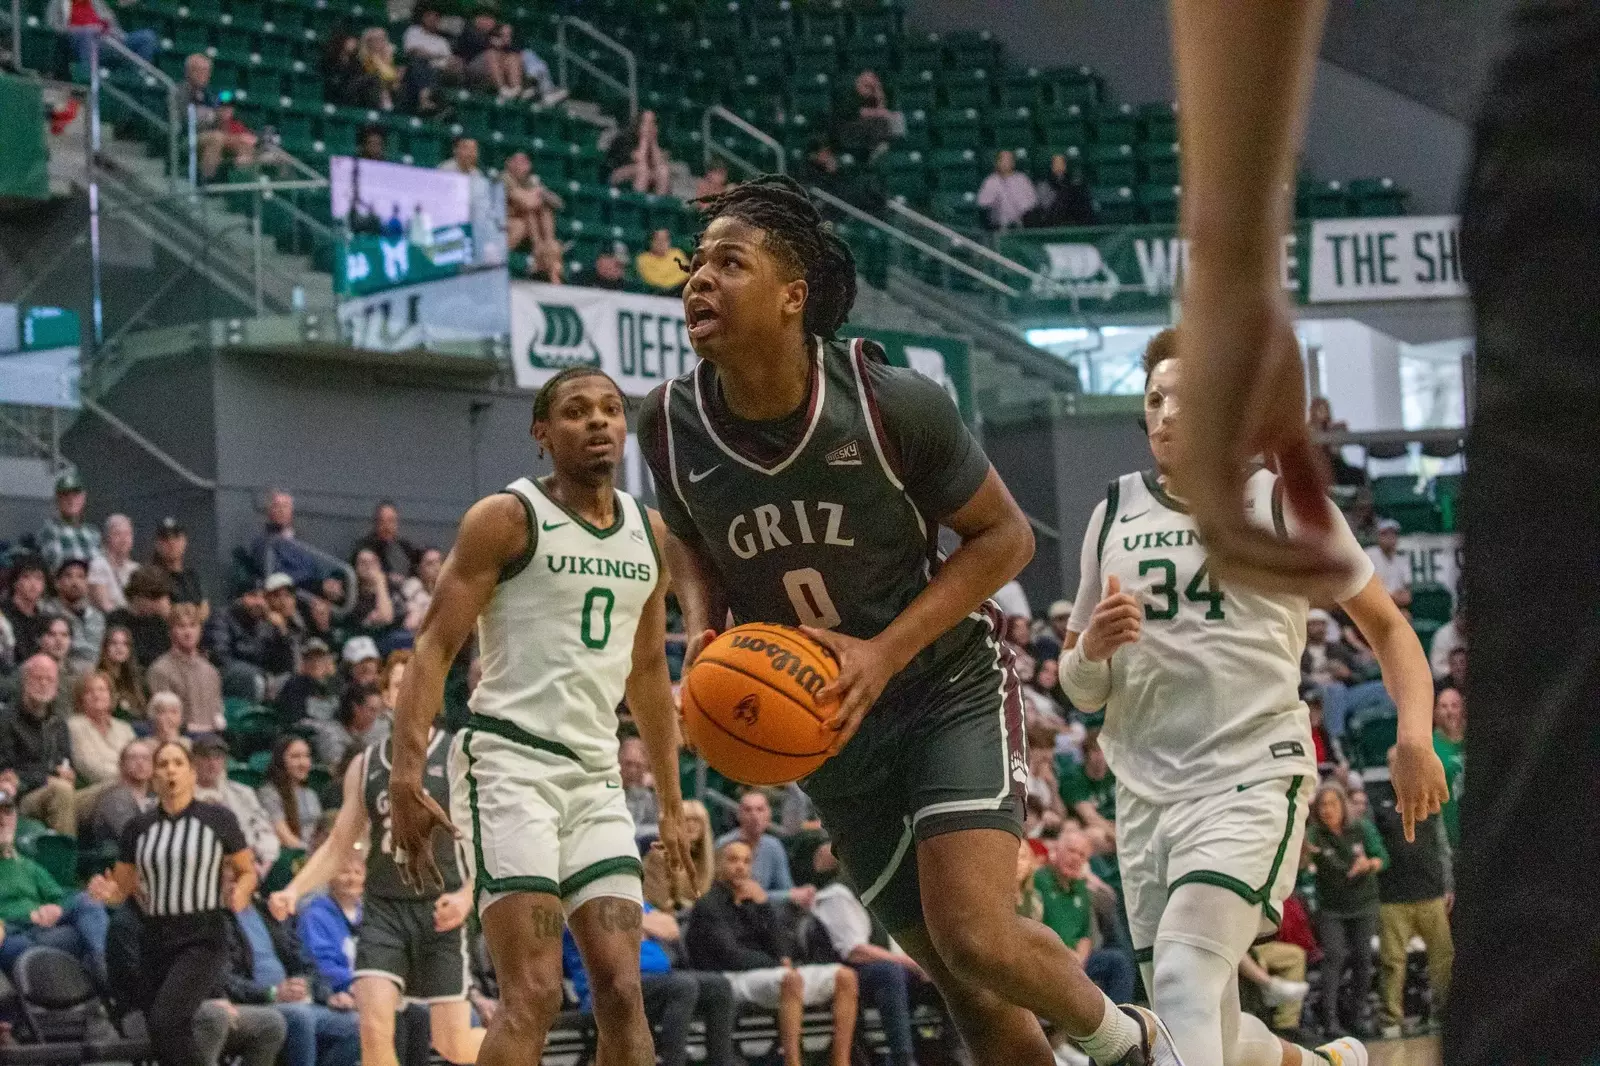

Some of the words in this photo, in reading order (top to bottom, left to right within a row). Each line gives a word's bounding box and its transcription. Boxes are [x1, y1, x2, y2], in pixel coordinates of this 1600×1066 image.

[1325, 232, 1399, 286] THE
[1413, 230, 1462, 283] SH
[838, 443, 858, 458] SKY
[727, 500, 855, 560] GRIZ
[546, 555, 651, 582] VIKINGS
[782, 567, 842, 629] 0
[1138, 558, 1226, 620] 34
[580, 587, 615, 650] 0
